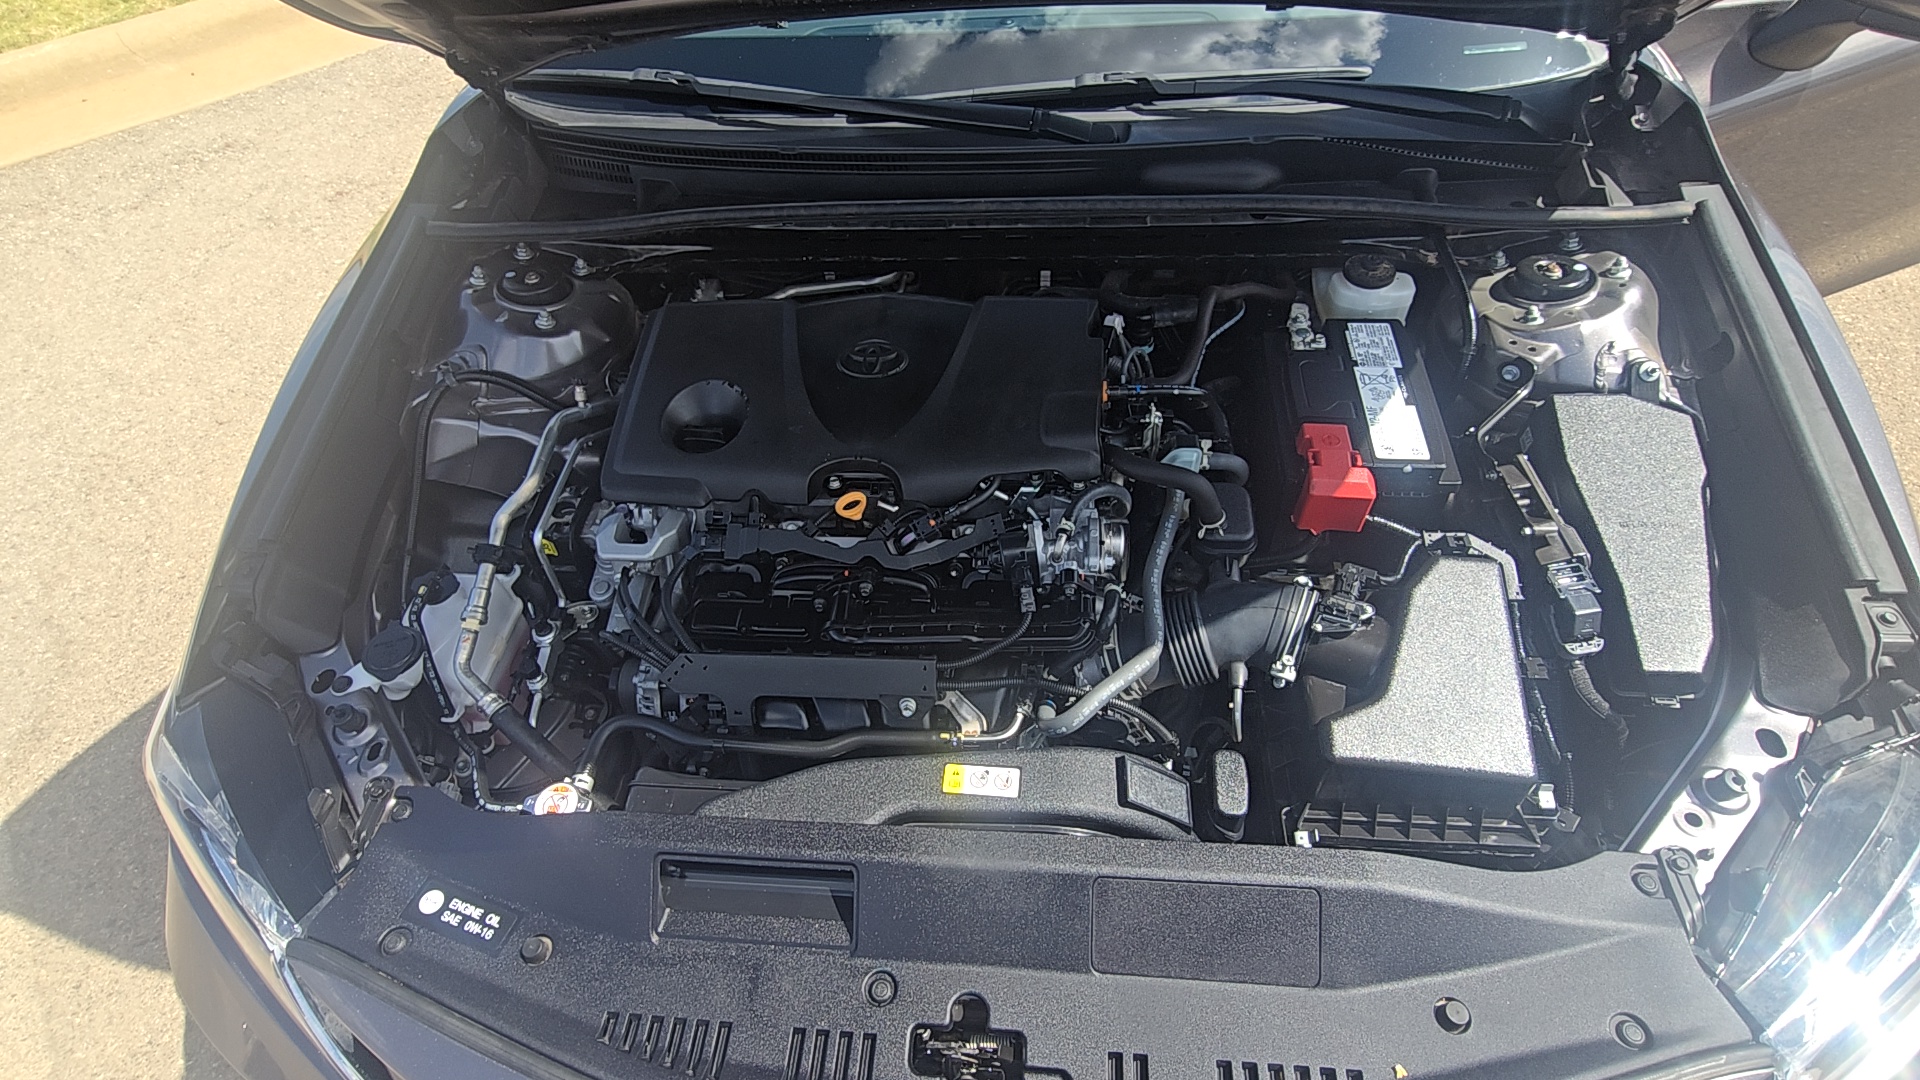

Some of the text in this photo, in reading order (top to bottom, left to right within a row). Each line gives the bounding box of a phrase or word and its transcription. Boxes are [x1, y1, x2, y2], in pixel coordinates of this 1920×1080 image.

[440, 910, 463, 927] SAE
[448, 897, 485, 920] ENGINE
[485, 913, 501, 929] OIL
